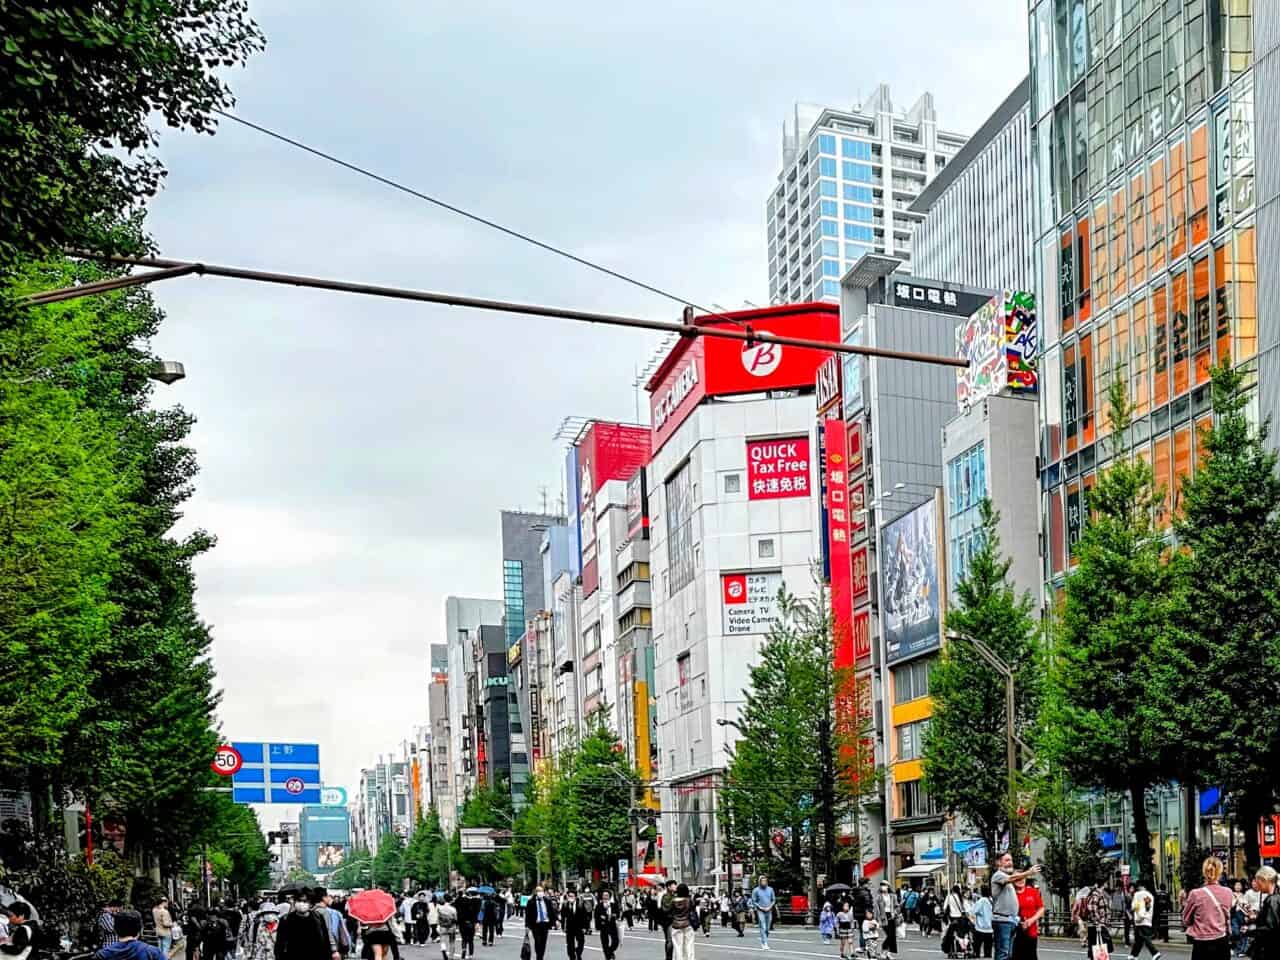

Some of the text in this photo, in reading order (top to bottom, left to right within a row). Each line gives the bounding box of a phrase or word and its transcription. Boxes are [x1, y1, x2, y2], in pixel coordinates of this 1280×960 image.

[751, 443, 797, 461] QUICK
[752, 459, 808, 474] Tax Free
[753, 476, 807, 494] 快速免税
[728, 608, 755, 616] Camera
[729, 615, 779, 625] Video Camera
[729, 625, 751, 633] Drone
[216, 753, 236, 768] 50
